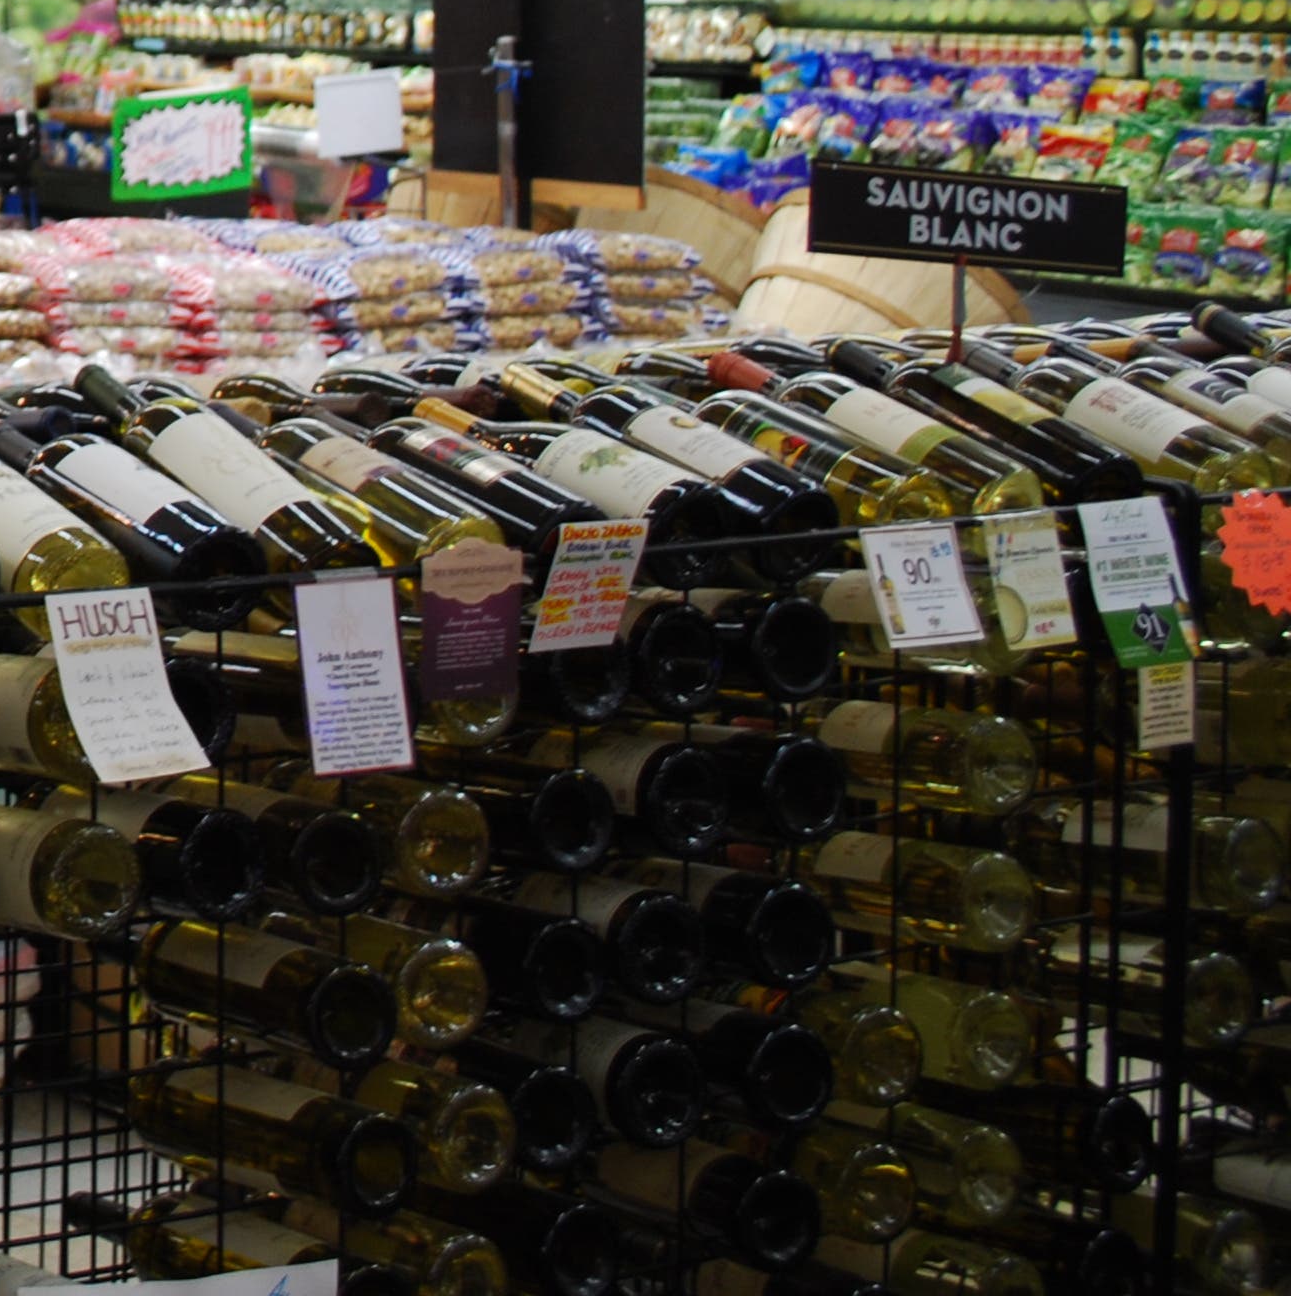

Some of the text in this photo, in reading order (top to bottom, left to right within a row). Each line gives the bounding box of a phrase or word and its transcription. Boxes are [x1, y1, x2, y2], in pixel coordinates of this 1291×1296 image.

[867, 176, 1070, 223] SAUVIGNON
[908, 214, 1023, 252] BLANC
[902, 557, 932, 585] 90
[57, 599, 153, 640] HUSCH
[1136, 612, 1166, 641] 91
